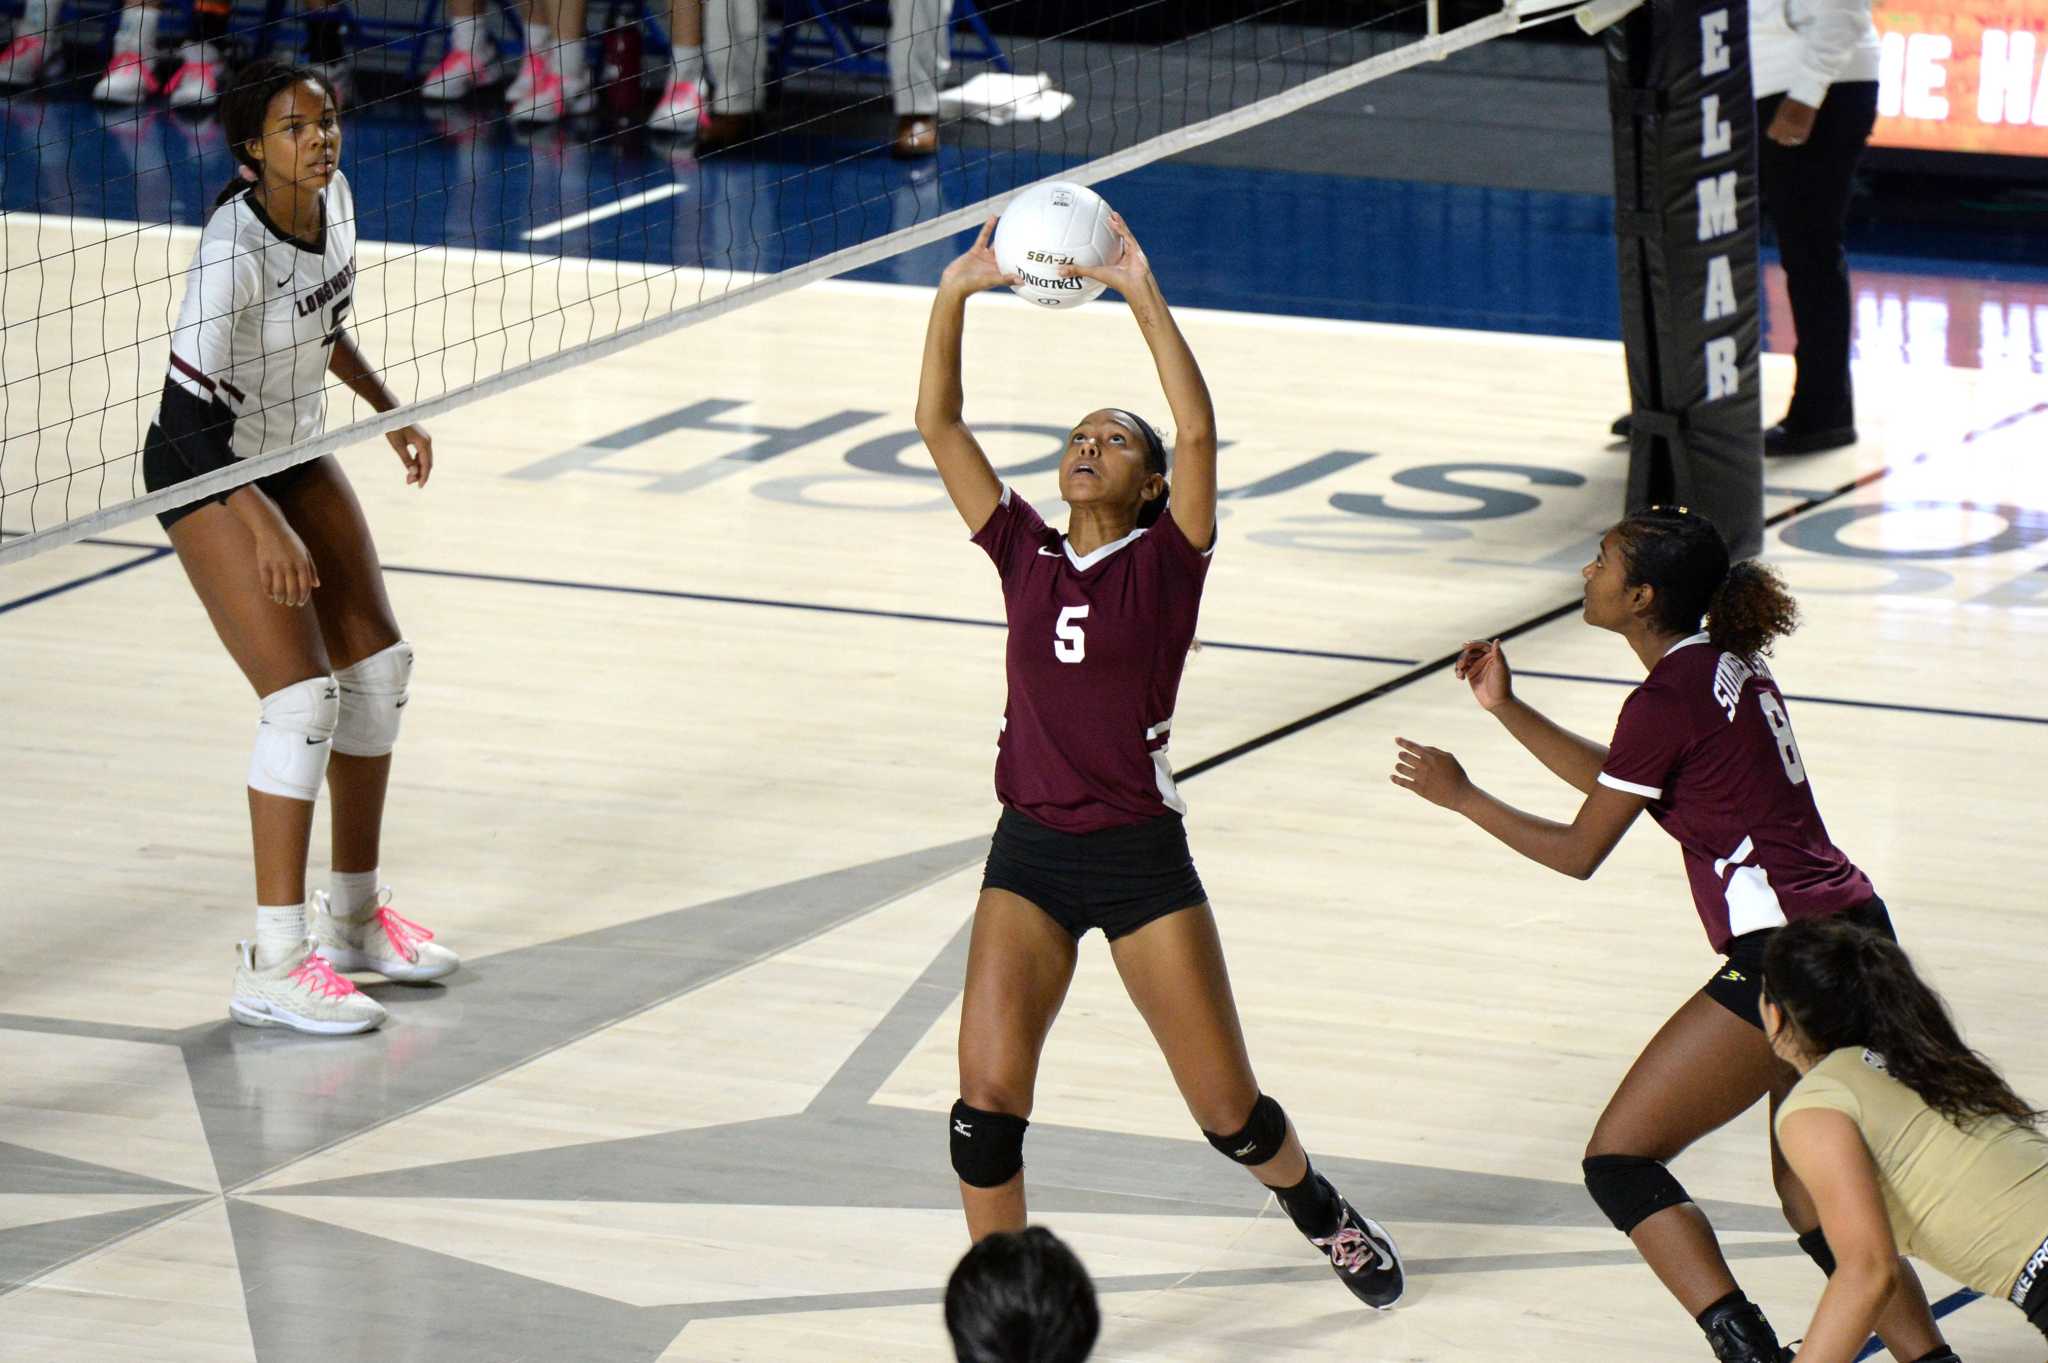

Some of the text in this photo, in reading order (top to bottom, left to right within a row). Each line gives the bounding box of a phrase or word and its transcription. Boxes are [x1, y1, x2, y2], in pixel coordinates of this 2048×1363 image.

[1015, 266, 1083, 290] SPALDING
[1054, 604, 1089, 663] 5
[1759, 692, 1805, 785] 8
